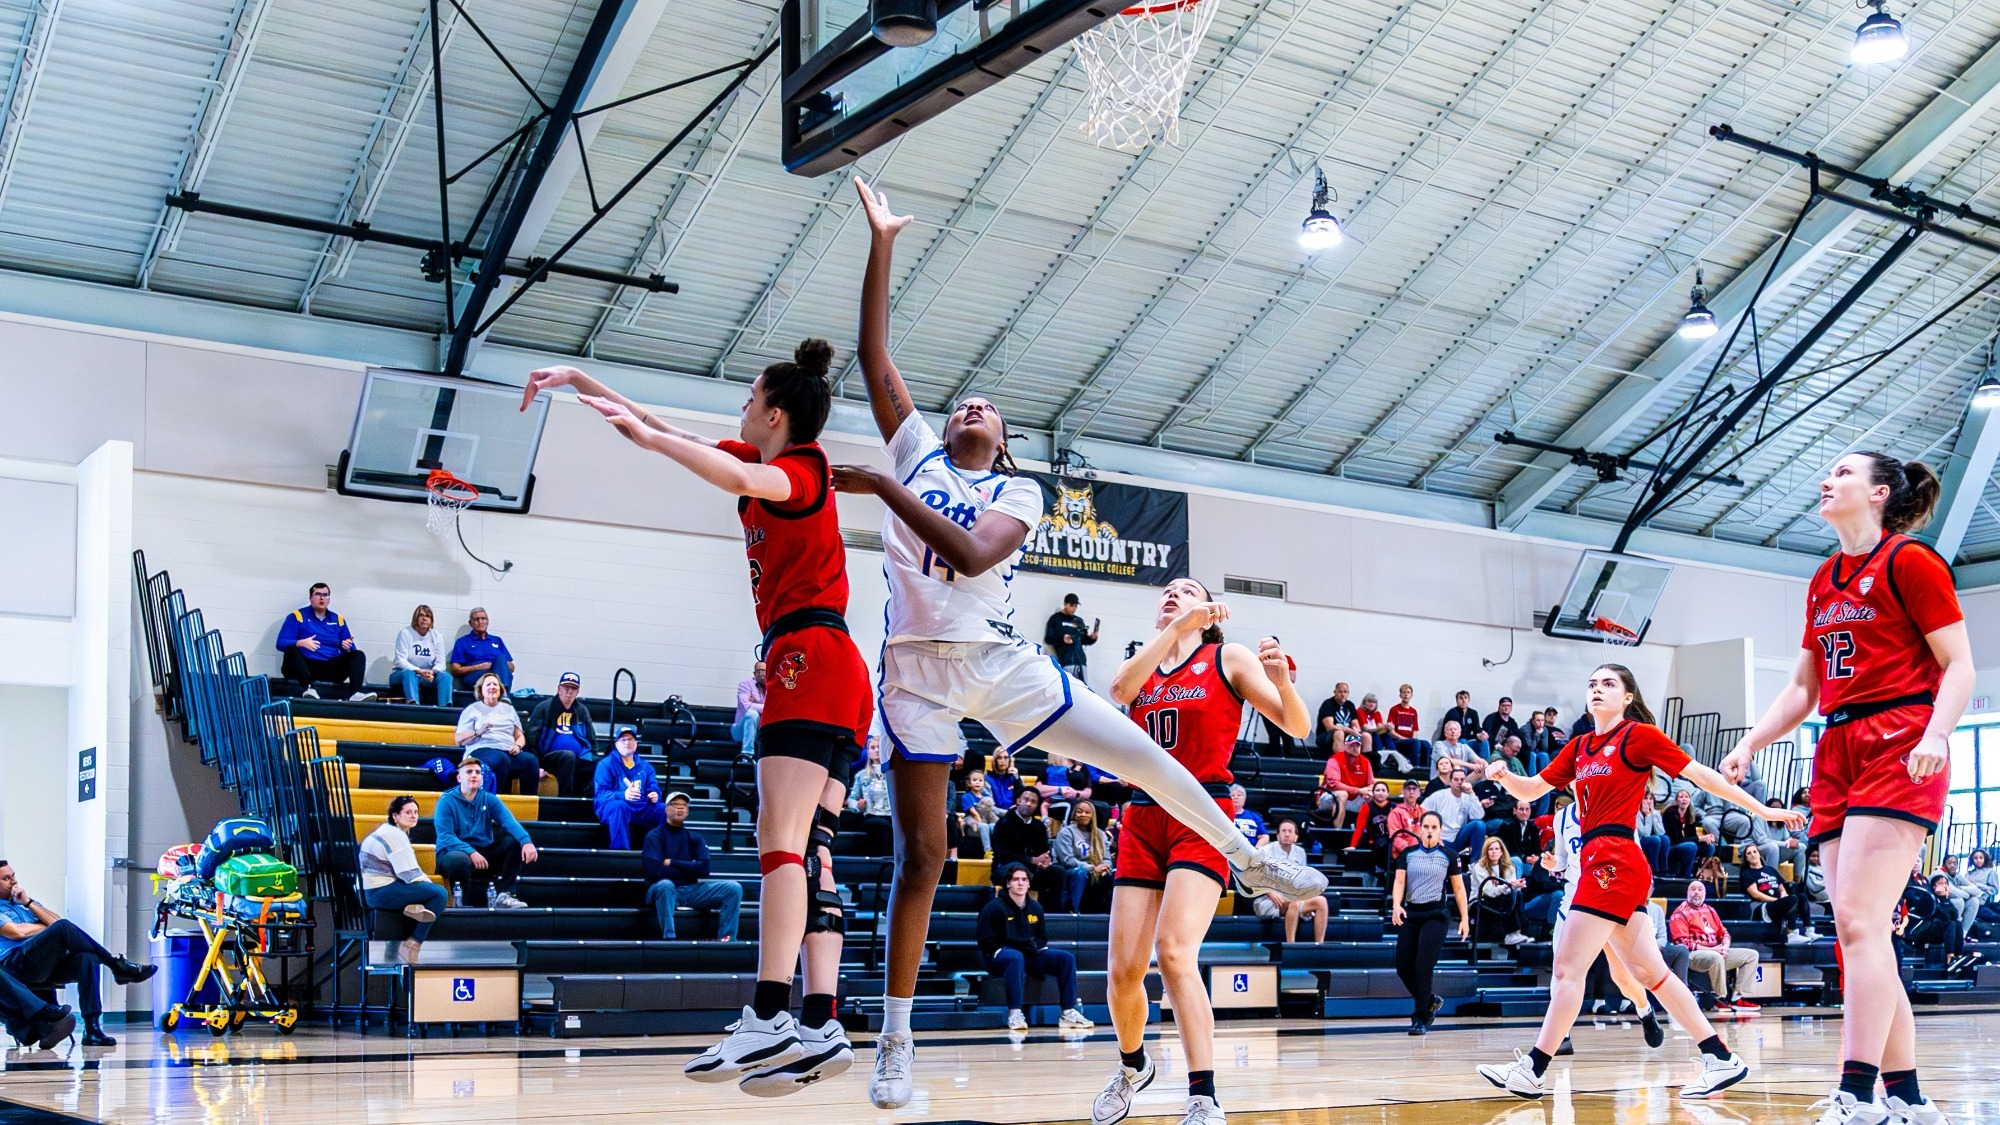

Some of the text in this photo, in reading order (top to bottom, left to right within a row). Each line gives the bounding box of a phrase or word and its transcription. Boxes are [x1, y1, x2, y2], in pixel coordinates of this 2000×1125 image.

[1067, 533, 1171, 568] COUNTRY
[1084, 562, 1105, 573] STATE
[1107, 564, 1135, 576] COLLEGE
[1835, 601, 1876, 623] State
[412, 644, 431, 657] Pitt
[1817, 631, 1856, 680] 42
[1163, 684, 1206, 703] State
[1145, 707, 1179, 750] 10
[1590, 761, 1612, 777] State
